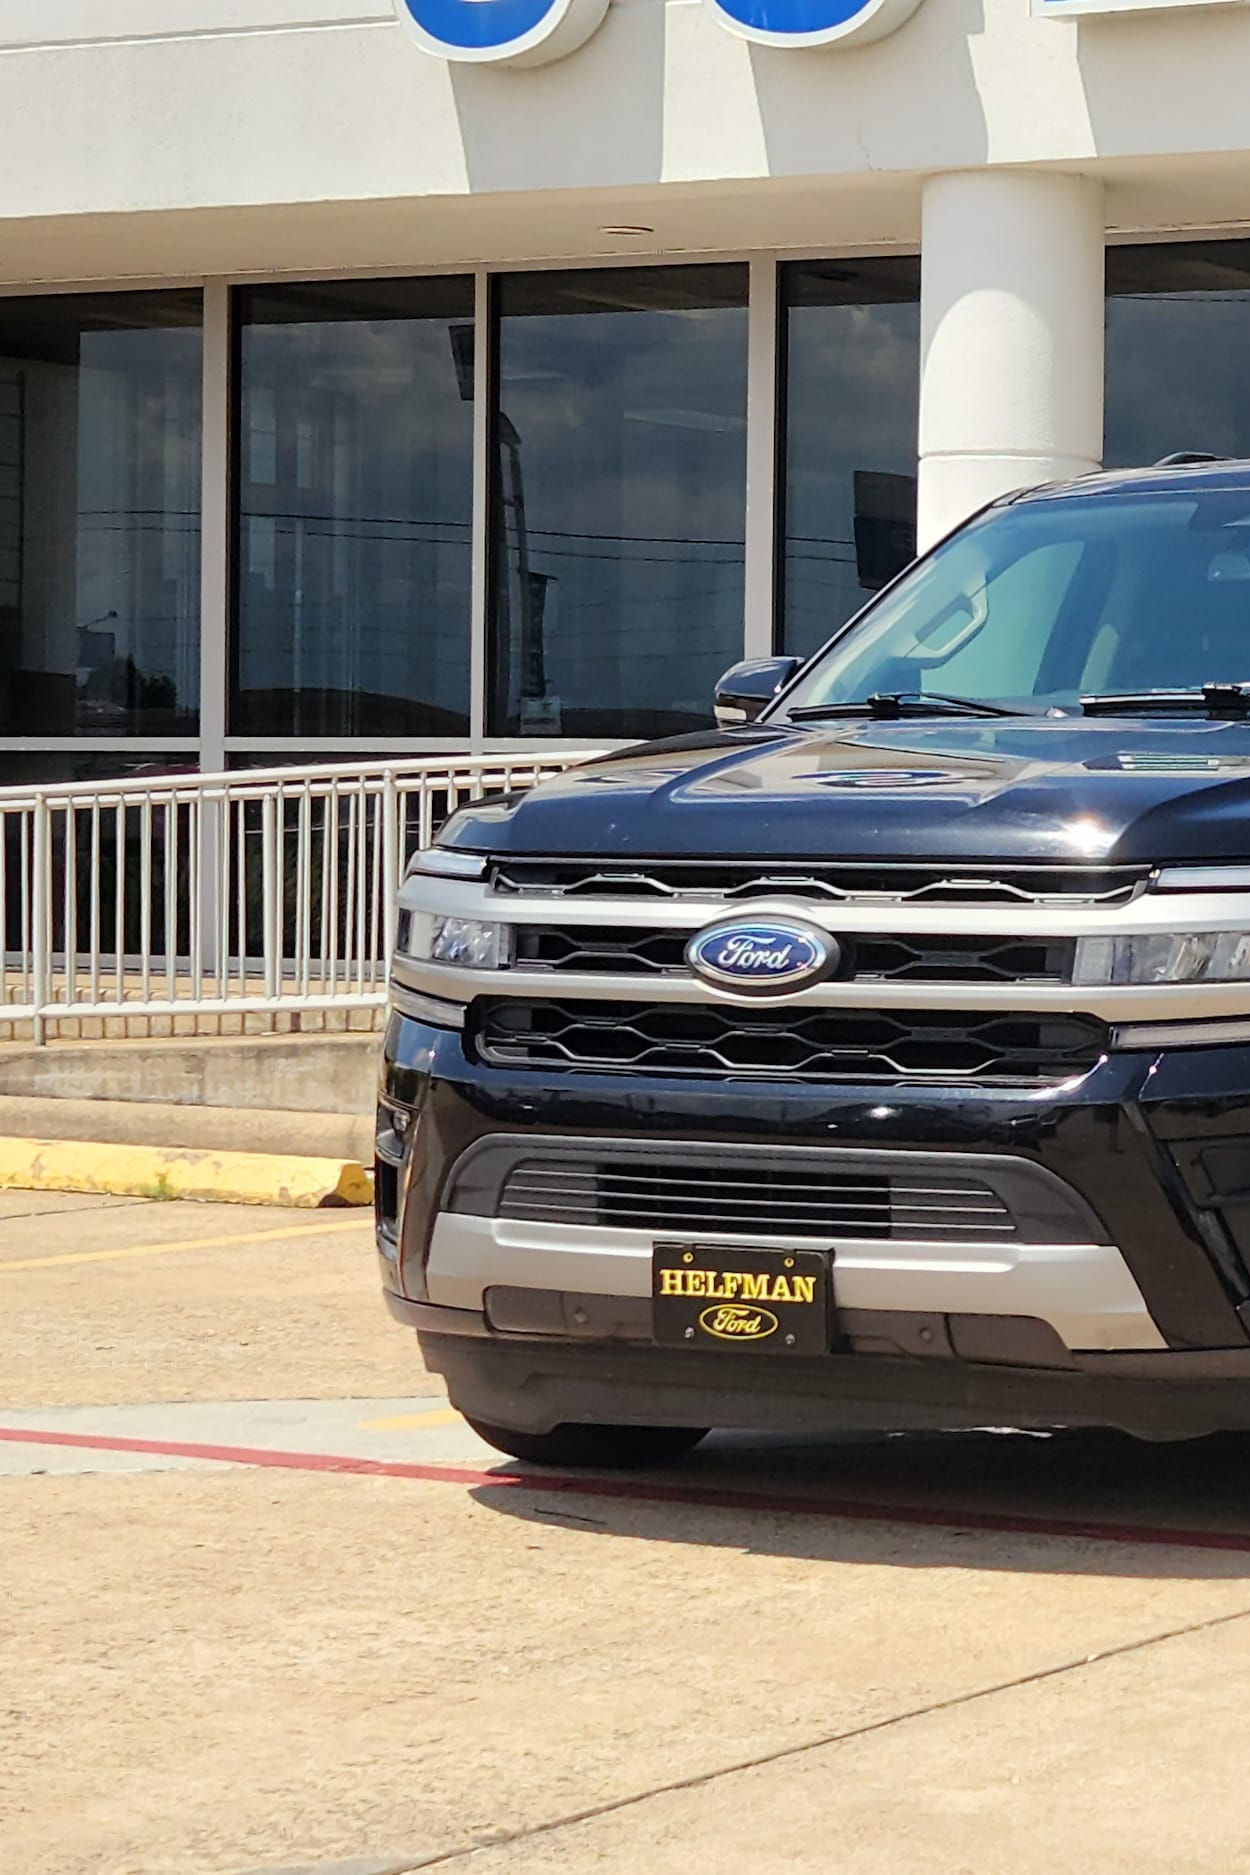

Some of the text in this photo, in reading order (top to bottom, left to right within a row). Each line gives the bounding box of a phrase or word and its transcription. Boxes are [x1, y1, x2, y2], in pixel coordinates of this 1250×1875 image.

[718, 935, 793, 969] Ford
[659, 1269, 816, 1303] HELFMAN
[713, 1308, 762, 1334] Ford
